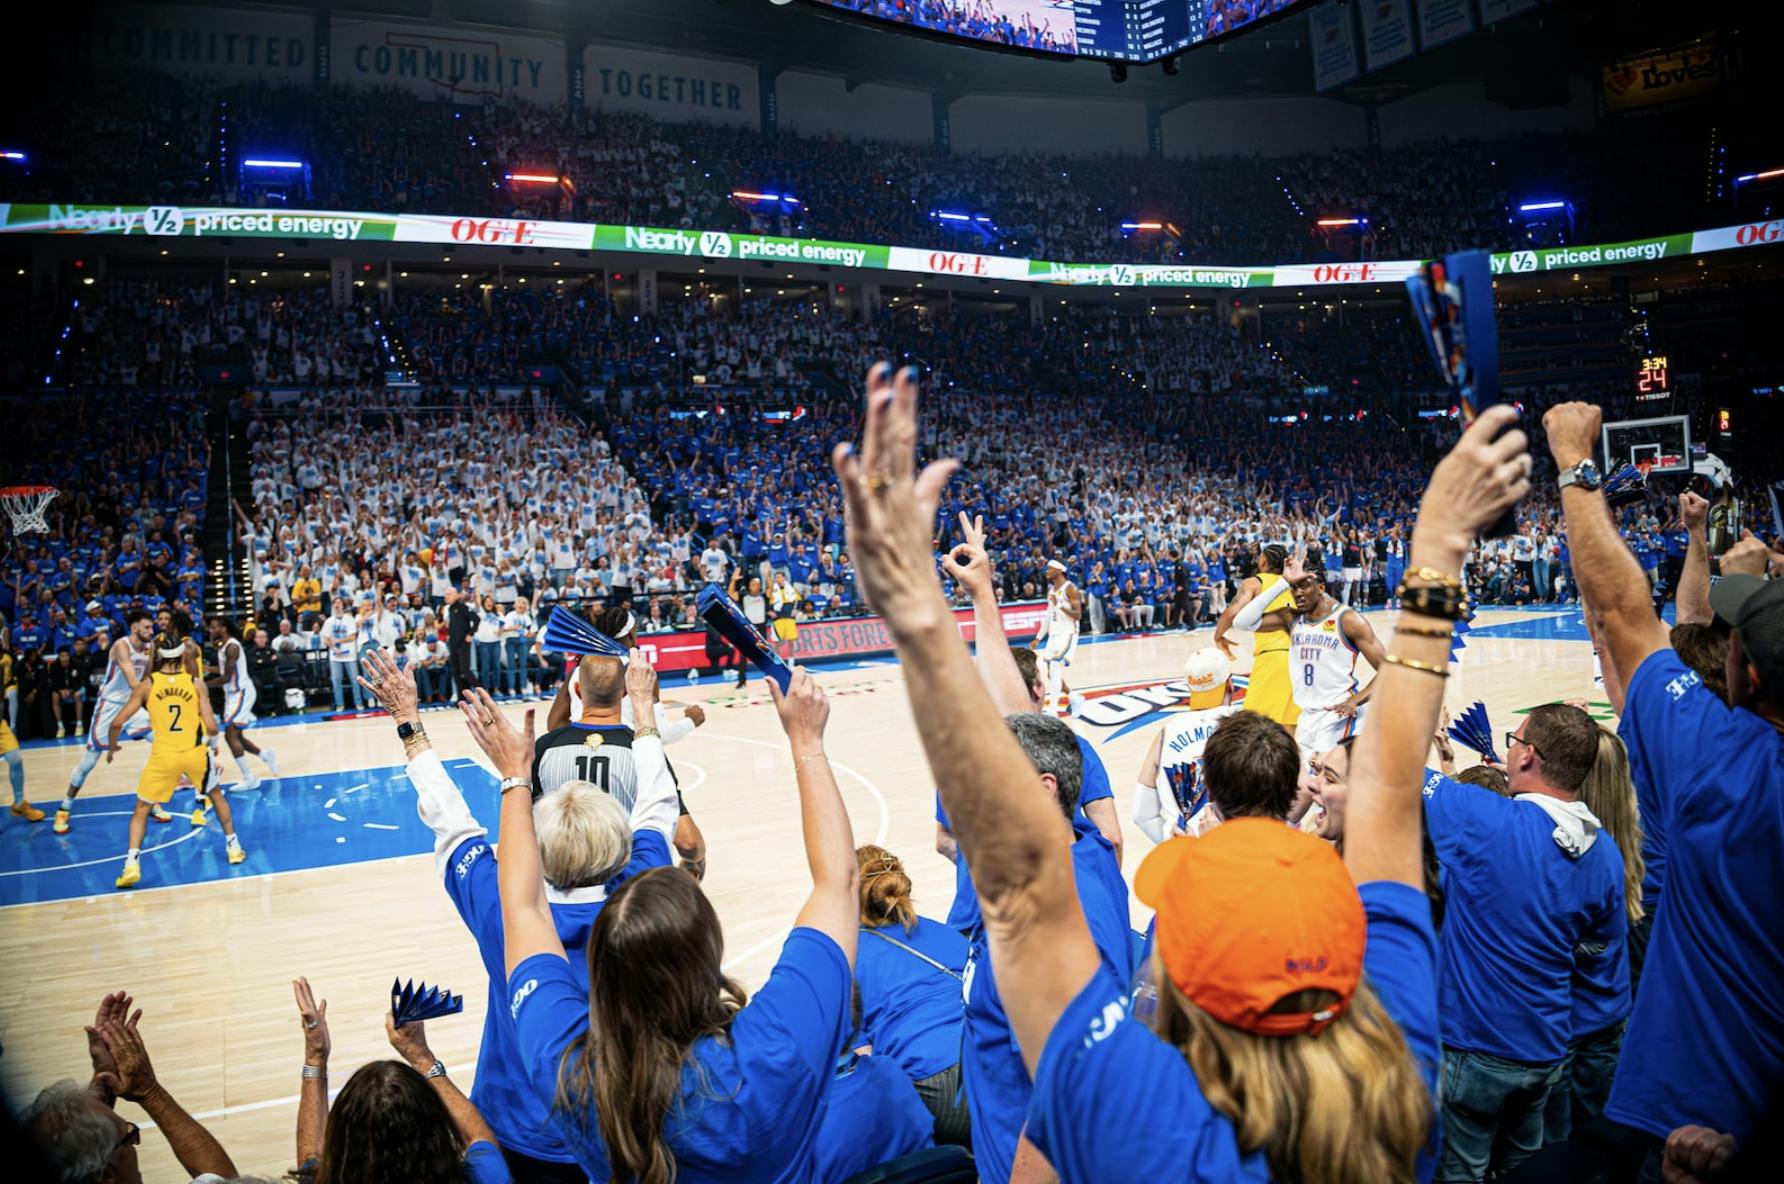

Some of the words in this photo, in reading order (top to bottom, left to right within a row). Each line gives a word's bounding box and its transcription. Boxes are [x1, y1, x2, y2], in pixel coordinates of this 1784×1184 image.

[102, 28, 305, 67] COMMITTED
[354, 44, 543, 87] COMMUNITY
[599, 68, 742, 110] TOGETHER
[194, 214, 273, 236] priced
[279, 218, 363, 240] energy
[625, 226, 696, 256] Nearly
[739, 239, 799, 260] priced
[803, 245, 865, 267] energy
[1545, 246, 1600, 270] priced
[1605, 241, 1667, 263] energy
[1143, 267, 1193, 286] priced
[1197, 270, 1251, 288] energy
[1641, 356, 1667, 371] 3:34
[1638, 369, 1666, 391] 24
[1300, 647, 1322, 661] CITY
[1304, 663, 1314, 686] 8
[168, 704, 183, 732] 2
[576, 756, 610, 794] 10
